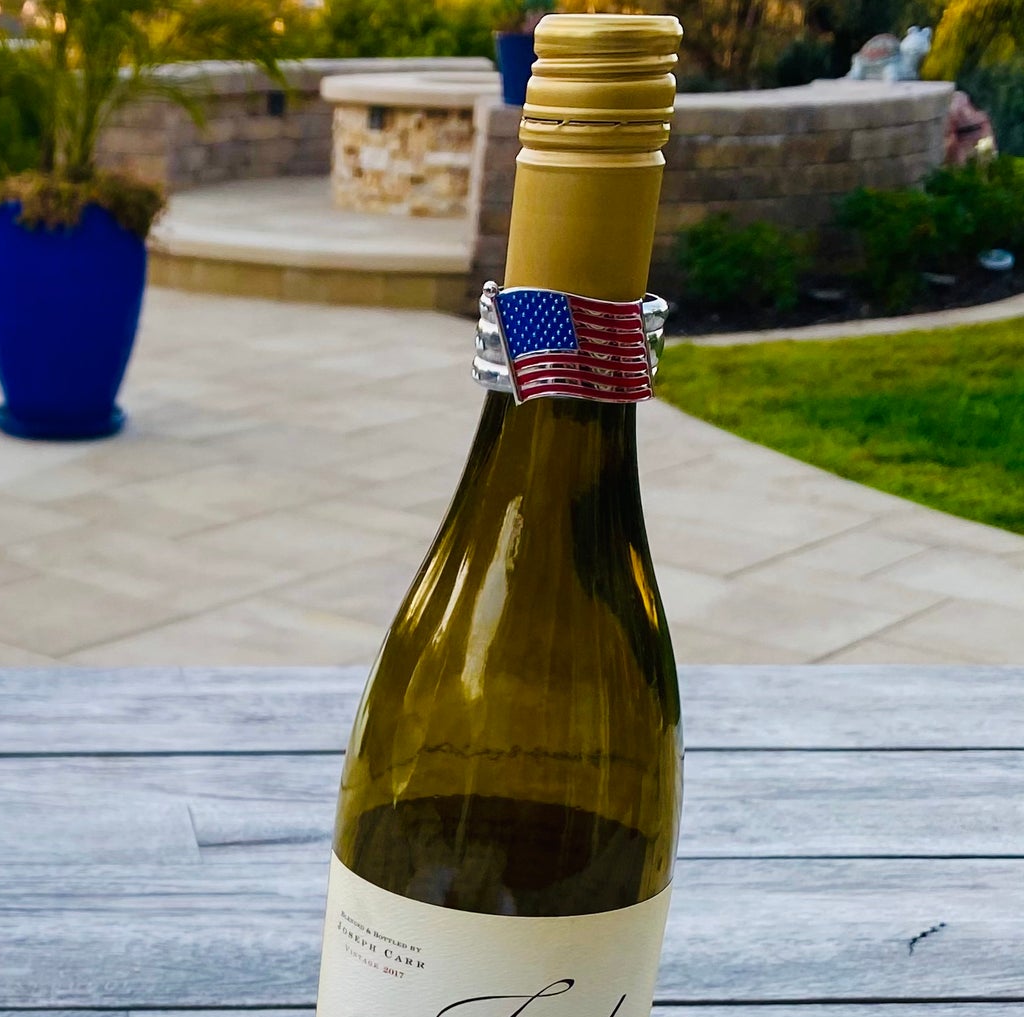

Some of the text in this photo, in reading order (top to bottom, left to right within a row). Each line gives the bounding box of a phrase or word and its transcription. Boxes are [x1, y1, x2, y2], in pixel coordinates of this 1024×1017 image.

[337, 921, 425, 969] JOSEPH CARR
[409, 945, 422, 953] BY
[383, 966, 405, 979] 2017
